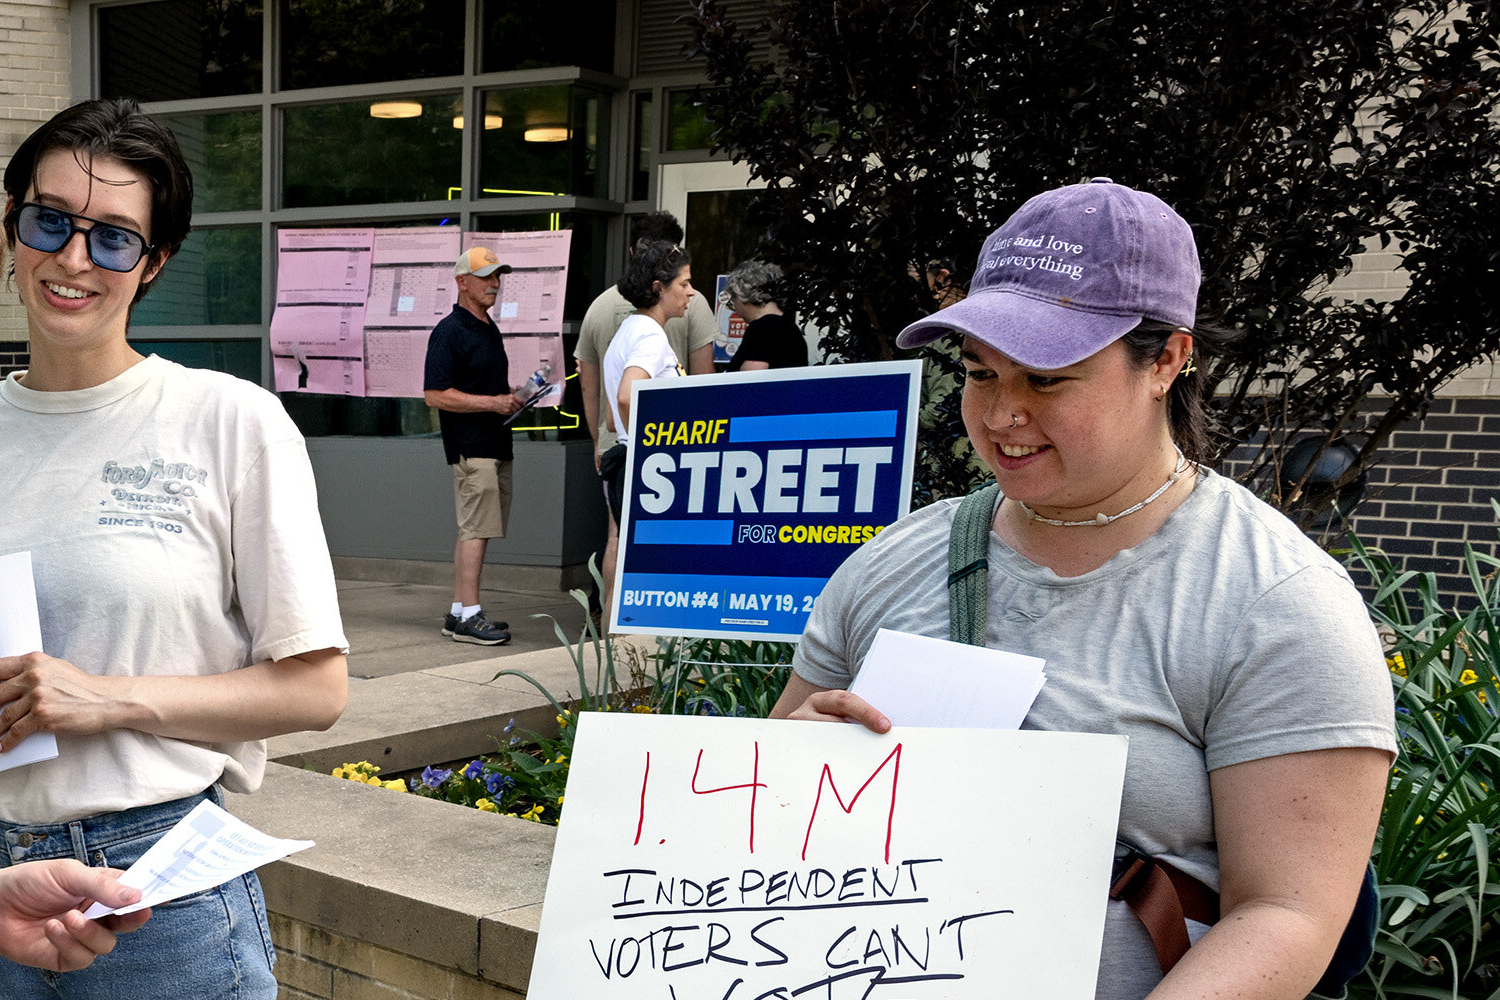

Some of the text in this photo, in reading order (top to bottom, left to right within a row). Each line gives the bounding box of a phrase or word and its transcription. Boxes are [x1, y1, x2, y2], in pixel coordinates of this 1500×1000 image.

[1013, 235, 1045, 248] and
[1045, 235, 1084, 254] love
[1000, 256, 1084, 281] everything
[642, 418, 728, 447] SHARIF
[638, 446, 894, 514] STREET
[98, 517, 183, 534] SINCE 1903
[738, 525, 777, 544] FOR
[623, 590, 689, 609] BUTTON
[691, 592, 719, 610] #4
[729, 593, 773, 611] MAY
[775, 594, 798, 614] 19,
[603, 858, 943, 909] INDEPENDENT
[589, 910, 1014, 980] VOTERS CAN'T
